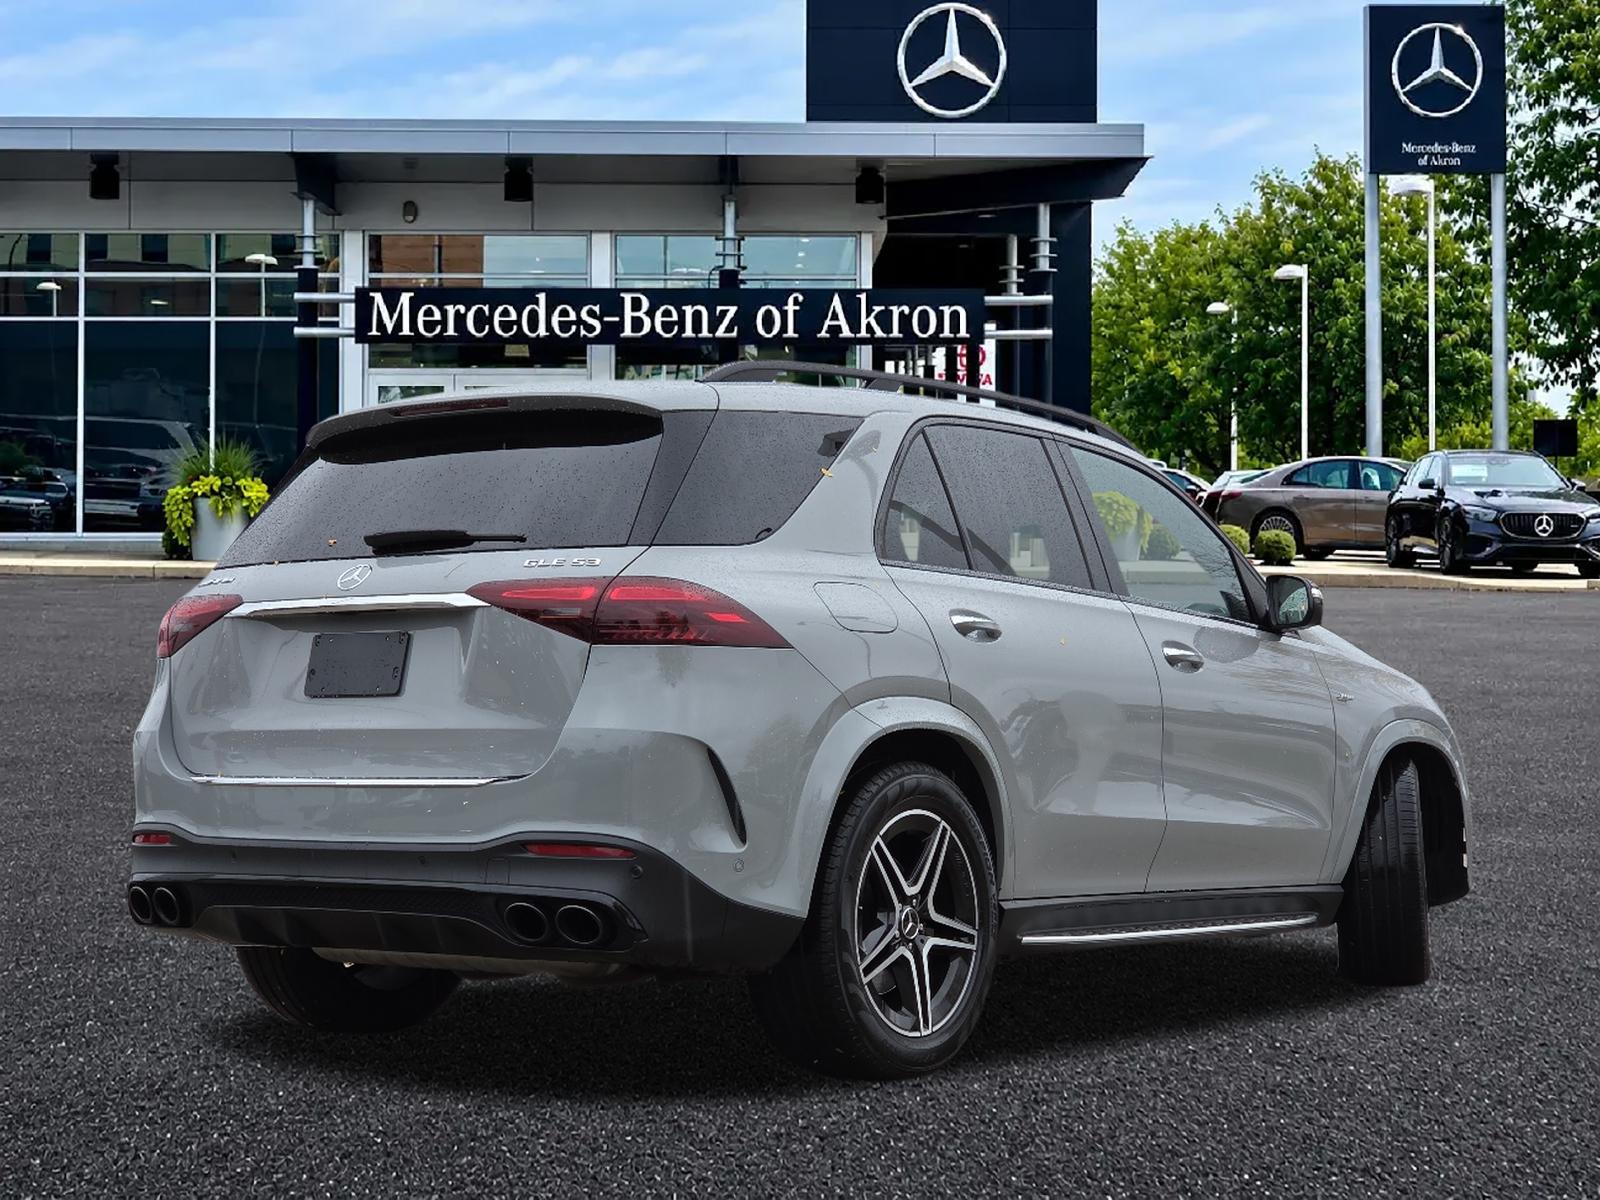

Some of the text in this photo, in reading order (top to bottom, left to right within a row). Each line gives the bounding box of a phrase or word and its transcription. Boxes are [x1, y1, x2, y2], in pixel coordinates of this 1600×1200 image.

[1401, 141, 1477, 153] Mercedes-Benz
[1418, 154, 1461, 166] of Akron
[367, 291, 970, 338] Mercedes-Benz of Akron
[523, 557, 566, 569] GLE
